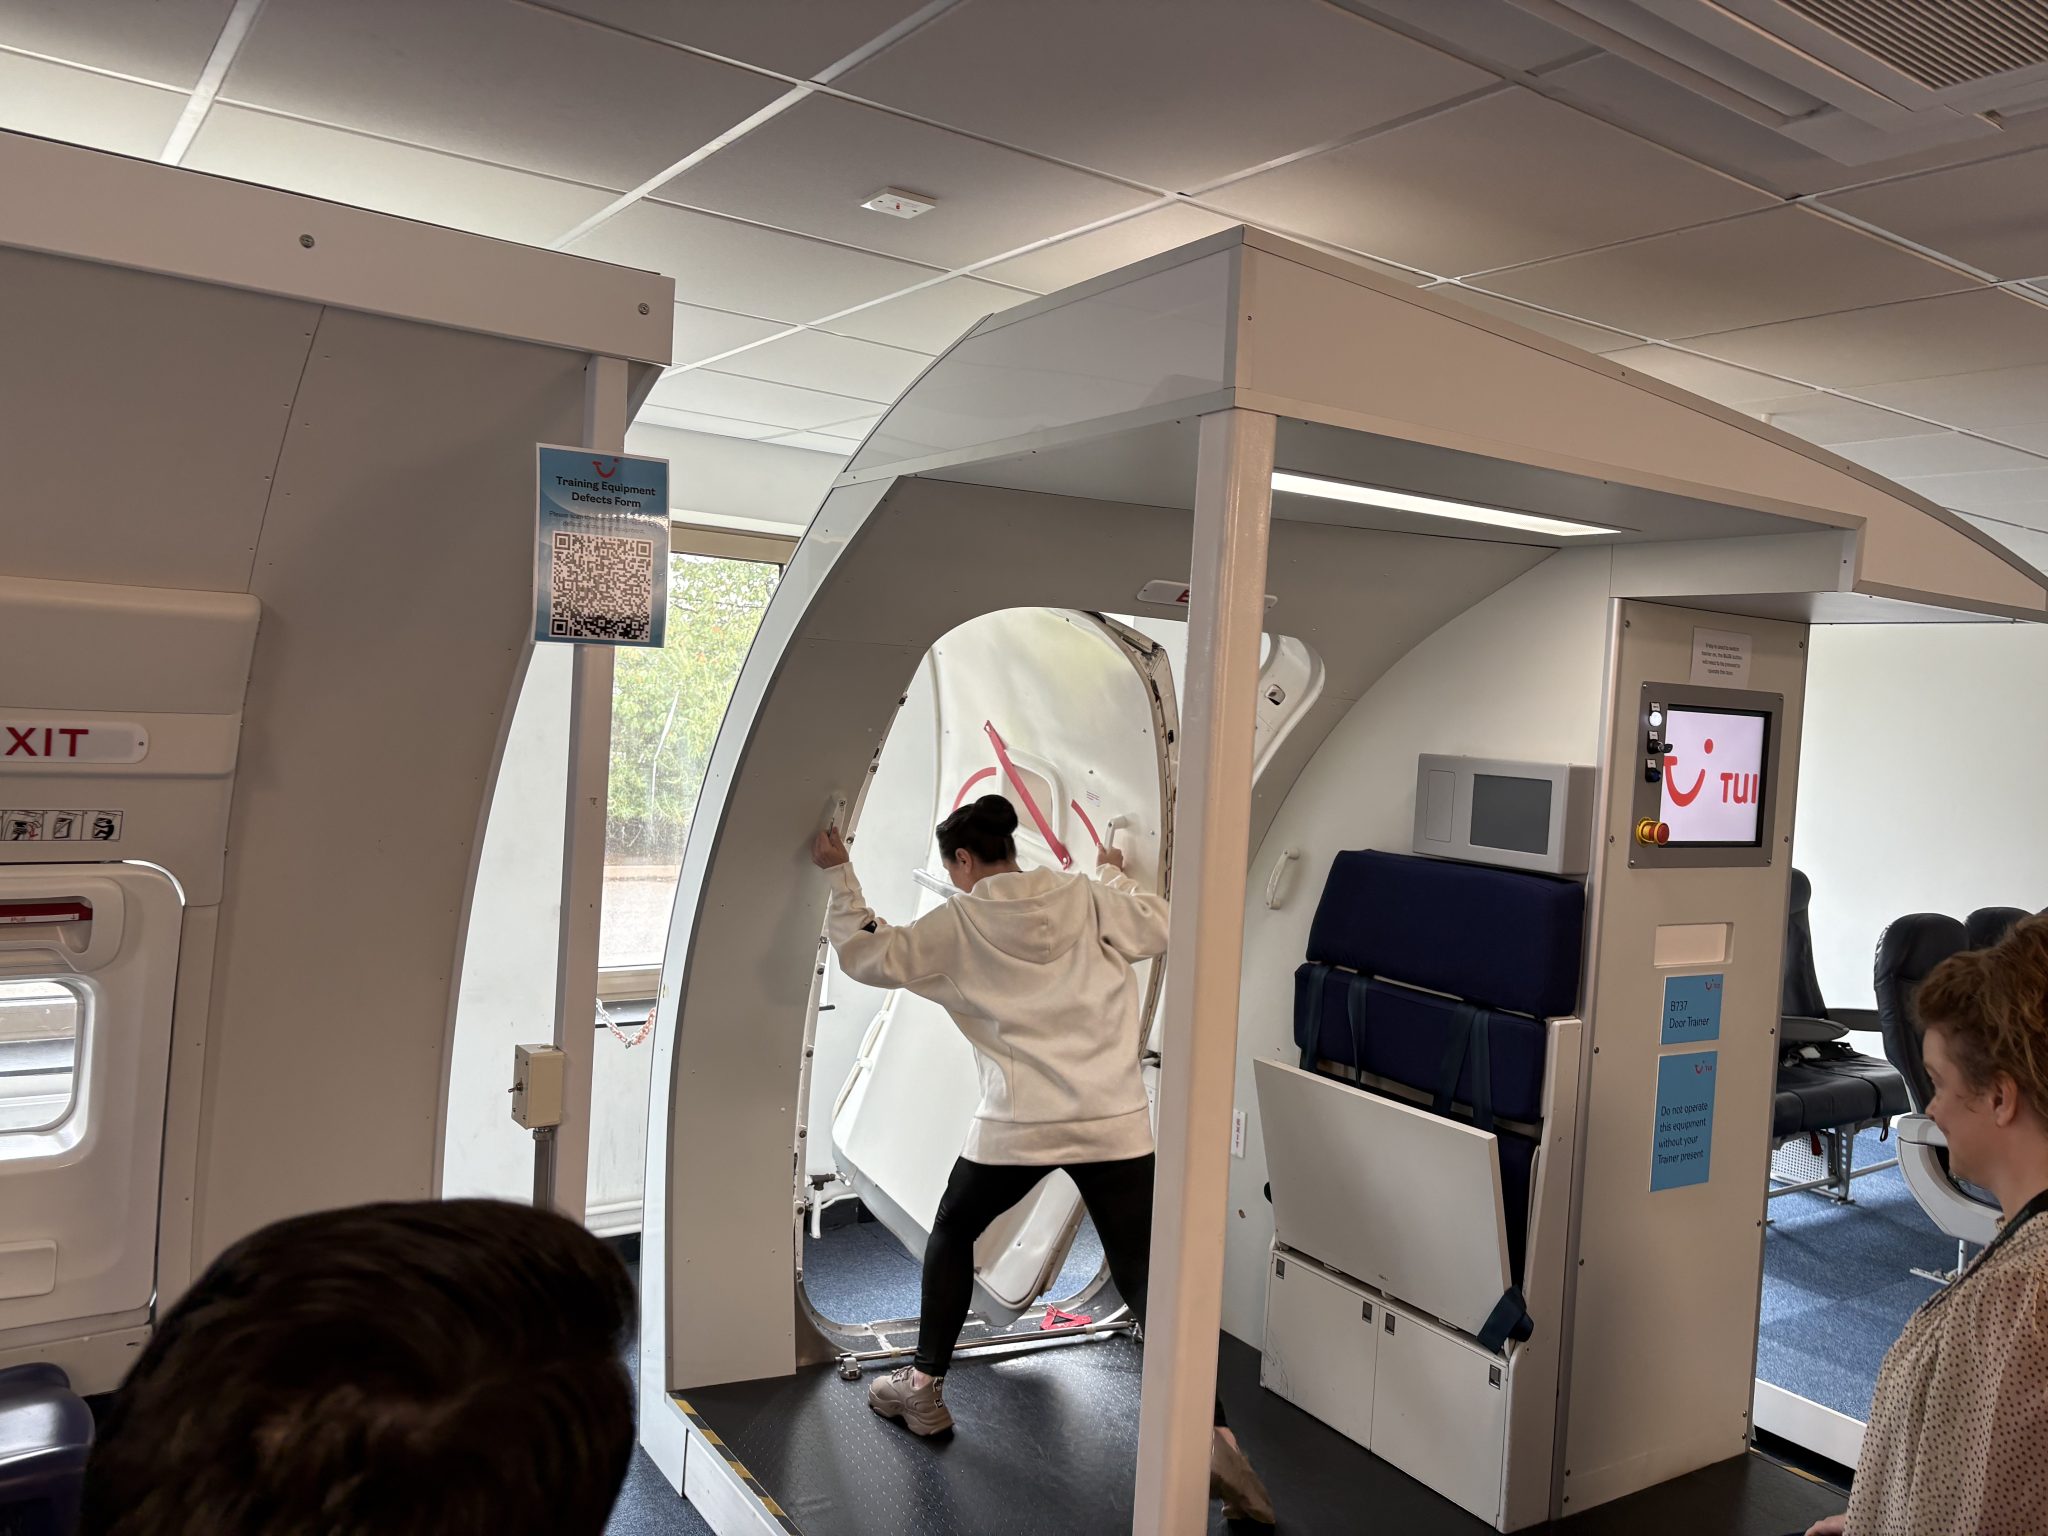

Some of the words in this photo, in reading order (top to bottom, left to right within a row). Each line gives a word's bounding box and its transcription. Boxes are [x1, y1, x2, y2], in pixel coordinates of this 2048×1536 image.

[556, 476, 599, 491] Training
[601, 481, 656, 496] Equipment
[571, 491, 612, 505] Defects
[614, 497, 641, 508] Form
[4, 726, 89, 757] XIT
[1720, 772, 1758, 804] TUI
[1670, 1000, 1688, 1012] B737
[1669, 1017, 1686, 1029] Door
[1687, 1016, 1710, 1027] Trainer
[1661, 1105, 1670, 1116] Do
[1672, 1105, 1683, 1114] not
[1684, 1102, 1708, 1115] operate
[1660, 1121, 1671, 1132] this
[1673, 1117, 1706, 1131] equipment
[1658, 1137, 1683, 1148] without
[1684, 1135, 1699, 1147] your
[1658, 1154, 1680, 1164] Trainer
[1680, 1149, 1704, 1161] present
